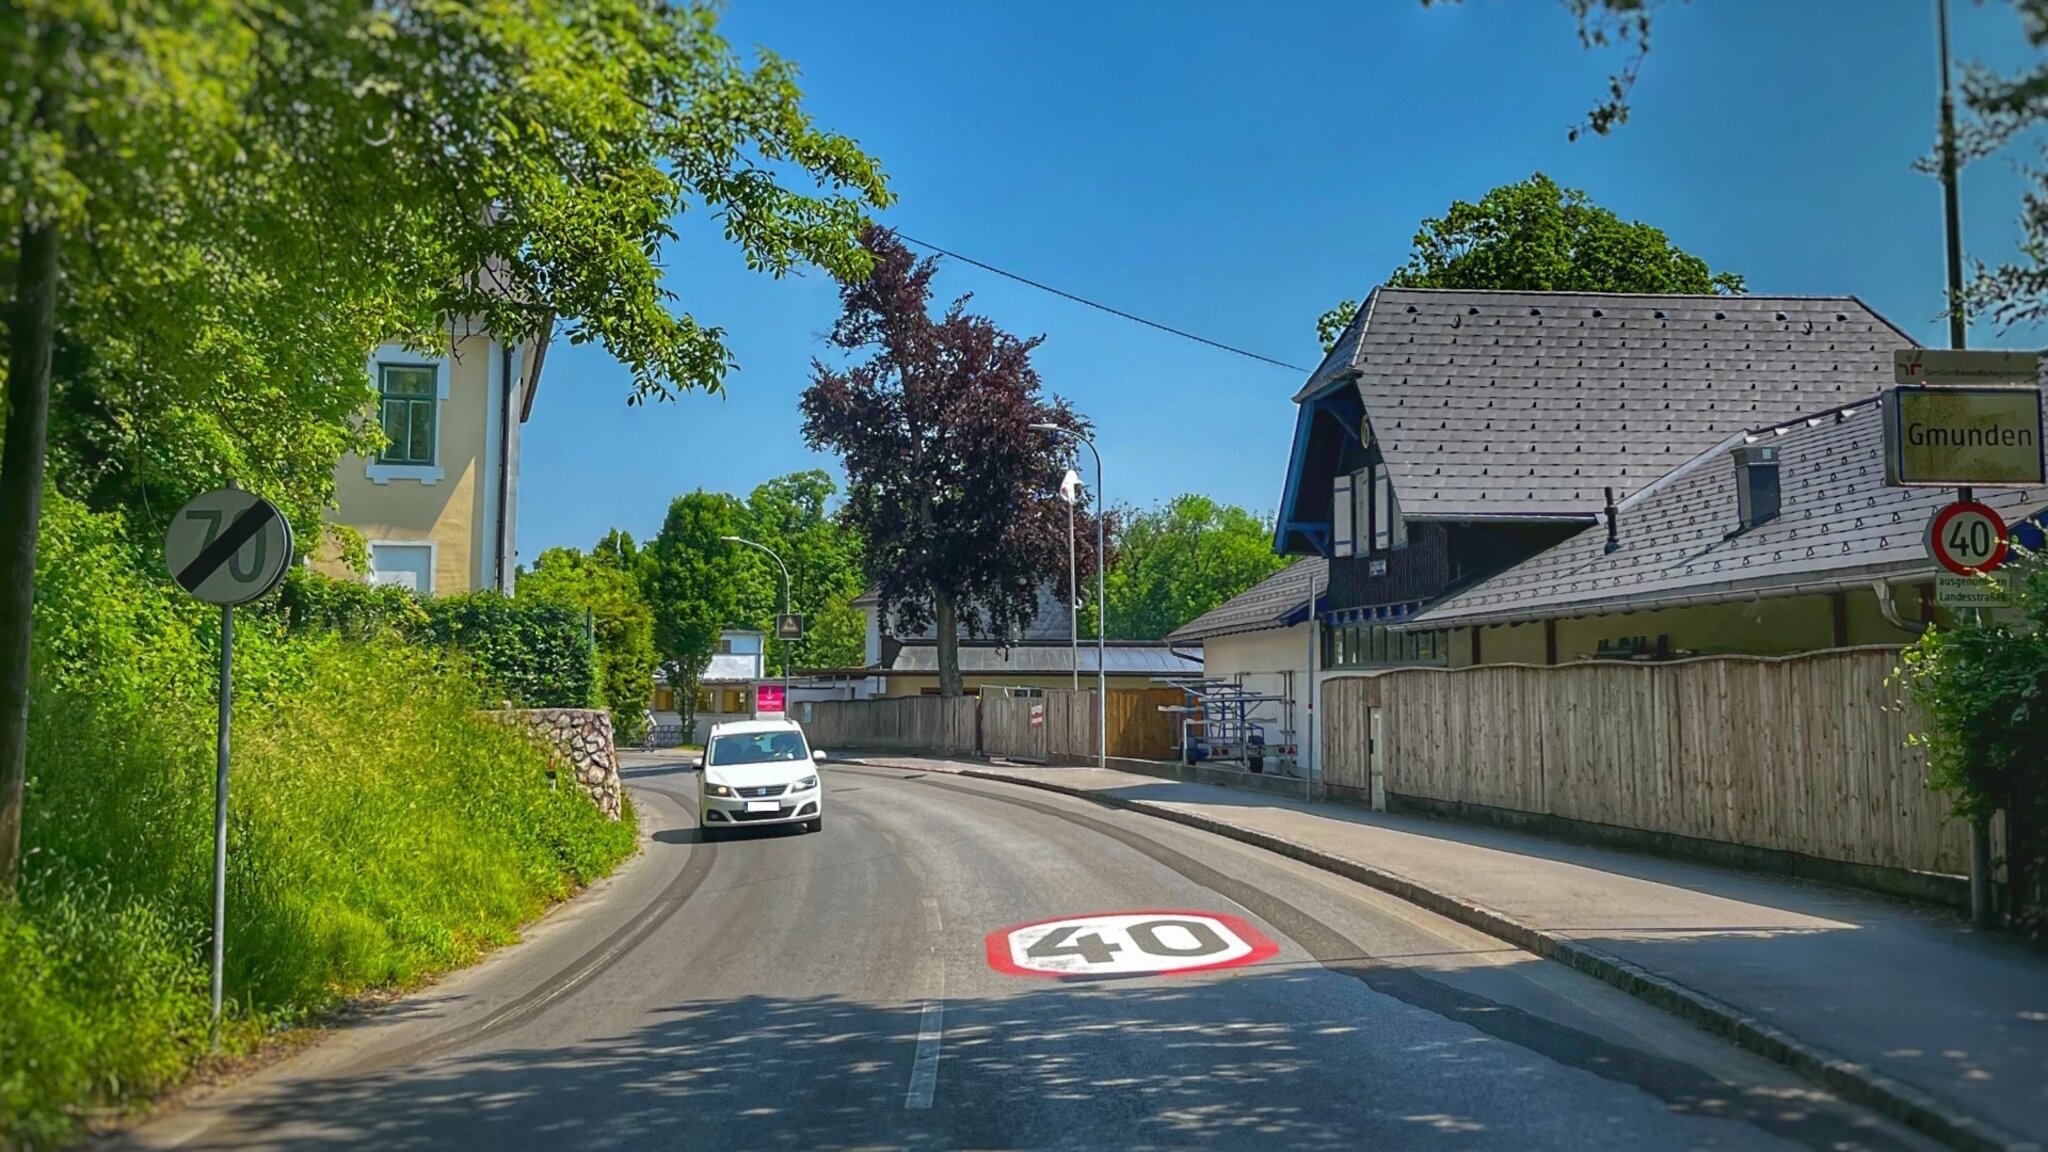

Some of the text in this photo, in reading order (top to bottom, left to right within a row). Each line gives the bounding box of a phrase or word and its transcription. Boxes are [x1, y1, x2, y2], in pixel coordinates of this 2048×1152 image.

[1908, 422, 2032, 447] Gmunden
[186, 509, 267, 583] 70
[1949, 520, 1990, 558] 40
[1939, 577, 2007, 588] ausgenomen
[1026, 919, 1231, 964] 40
